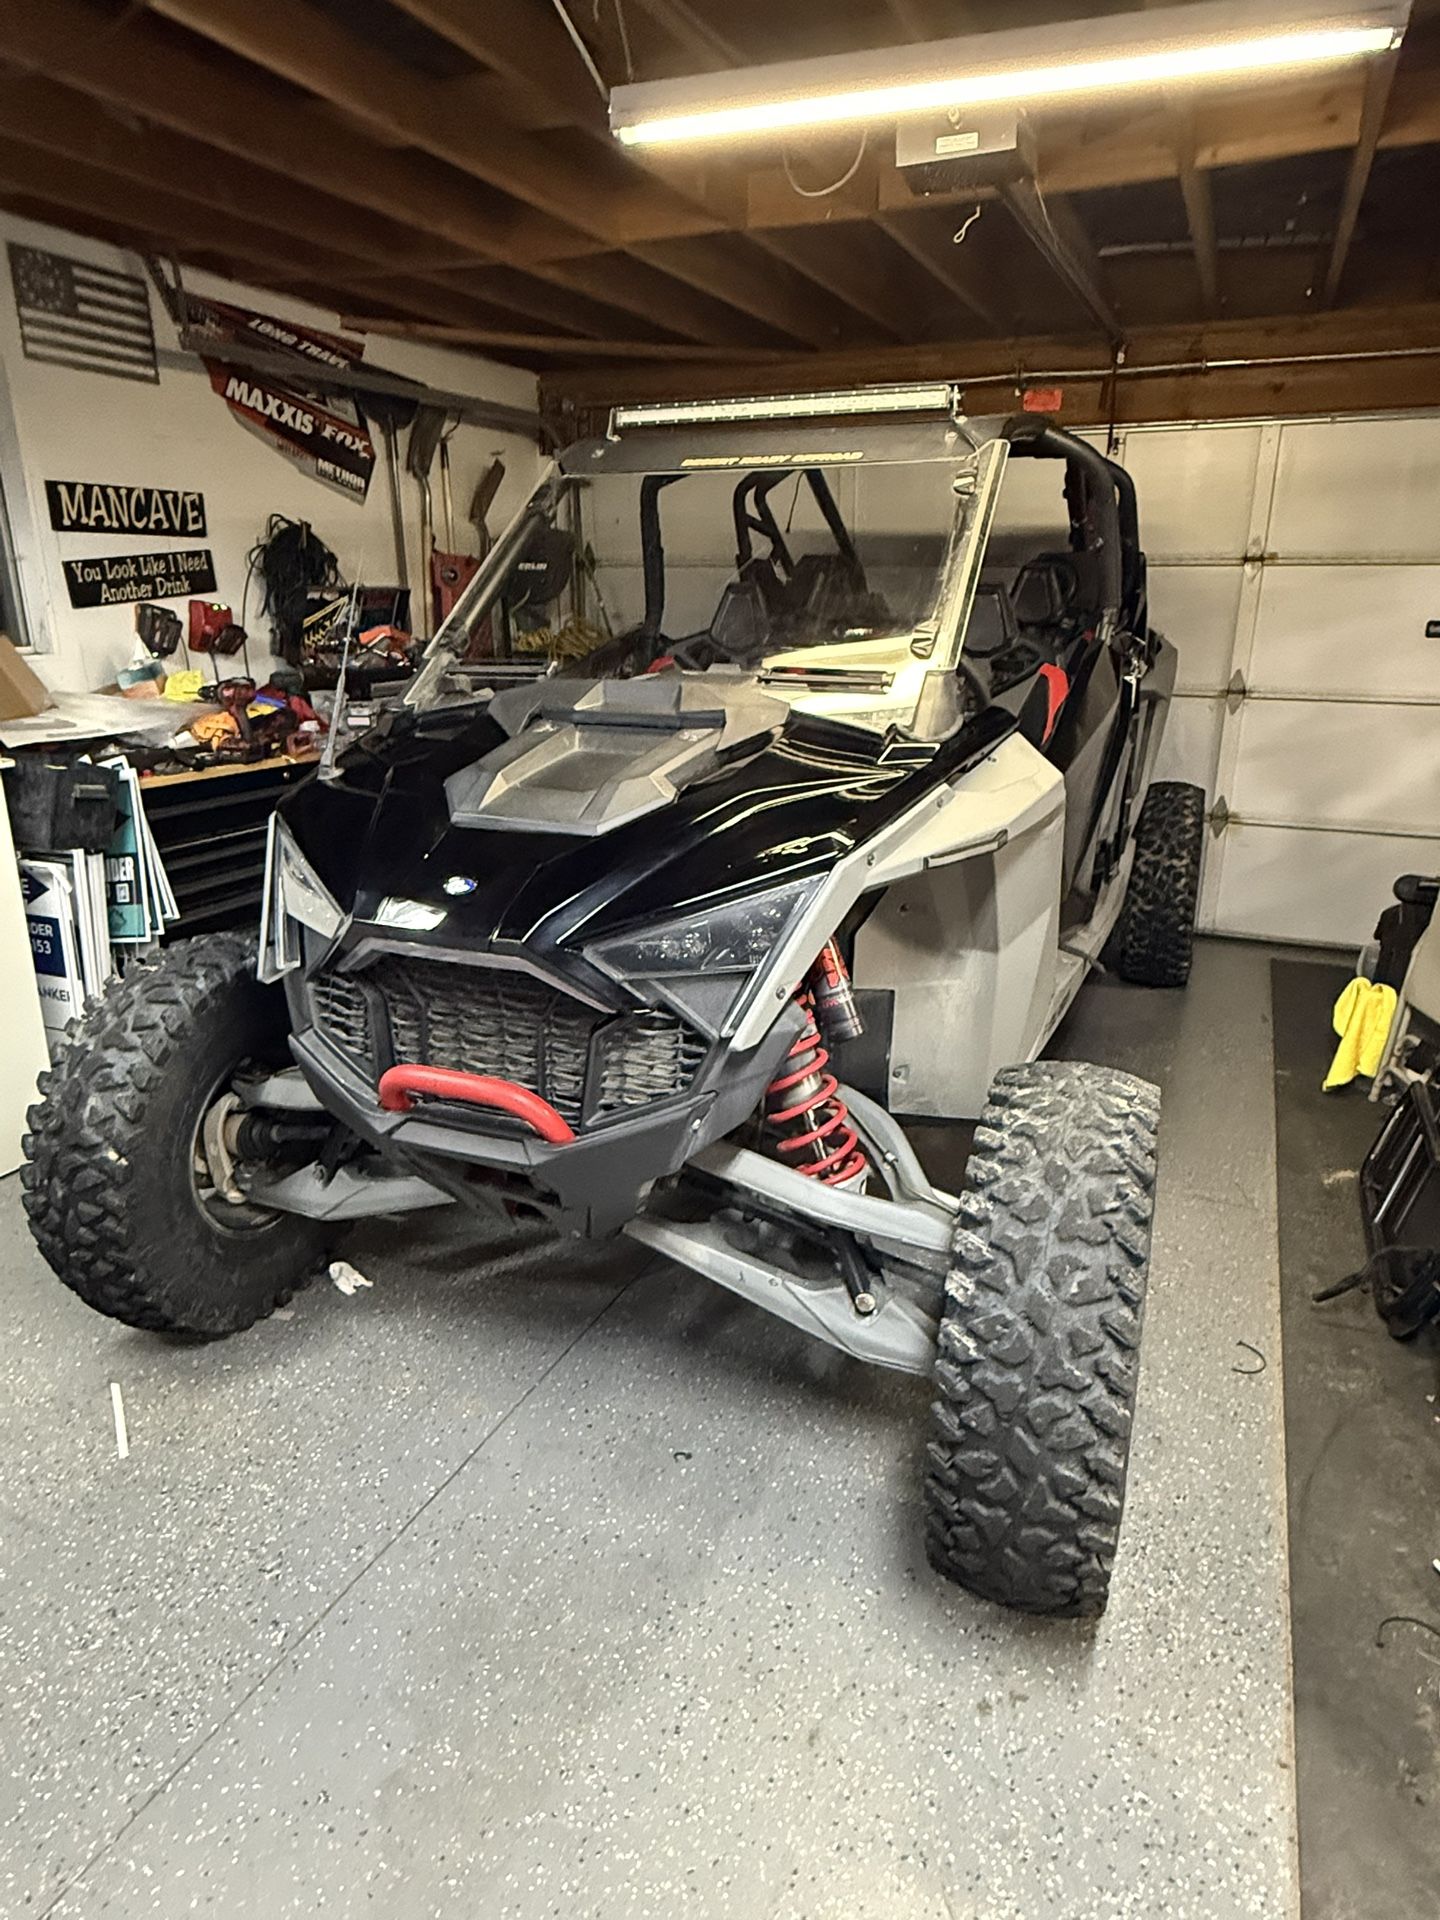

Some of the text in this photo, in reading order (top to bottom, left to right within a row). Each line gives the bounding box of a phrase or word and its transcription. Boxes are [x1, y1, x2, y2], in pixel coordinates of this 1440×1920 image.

[225, 377, 315, 435] MAXXIS
[321, 422, 371, 459] FOX
[57, 484, 204, 532] MANCAVE
[71, 551, 209, 583] You Look Like I Need
[101, 574, 192, 604] Another Drink
